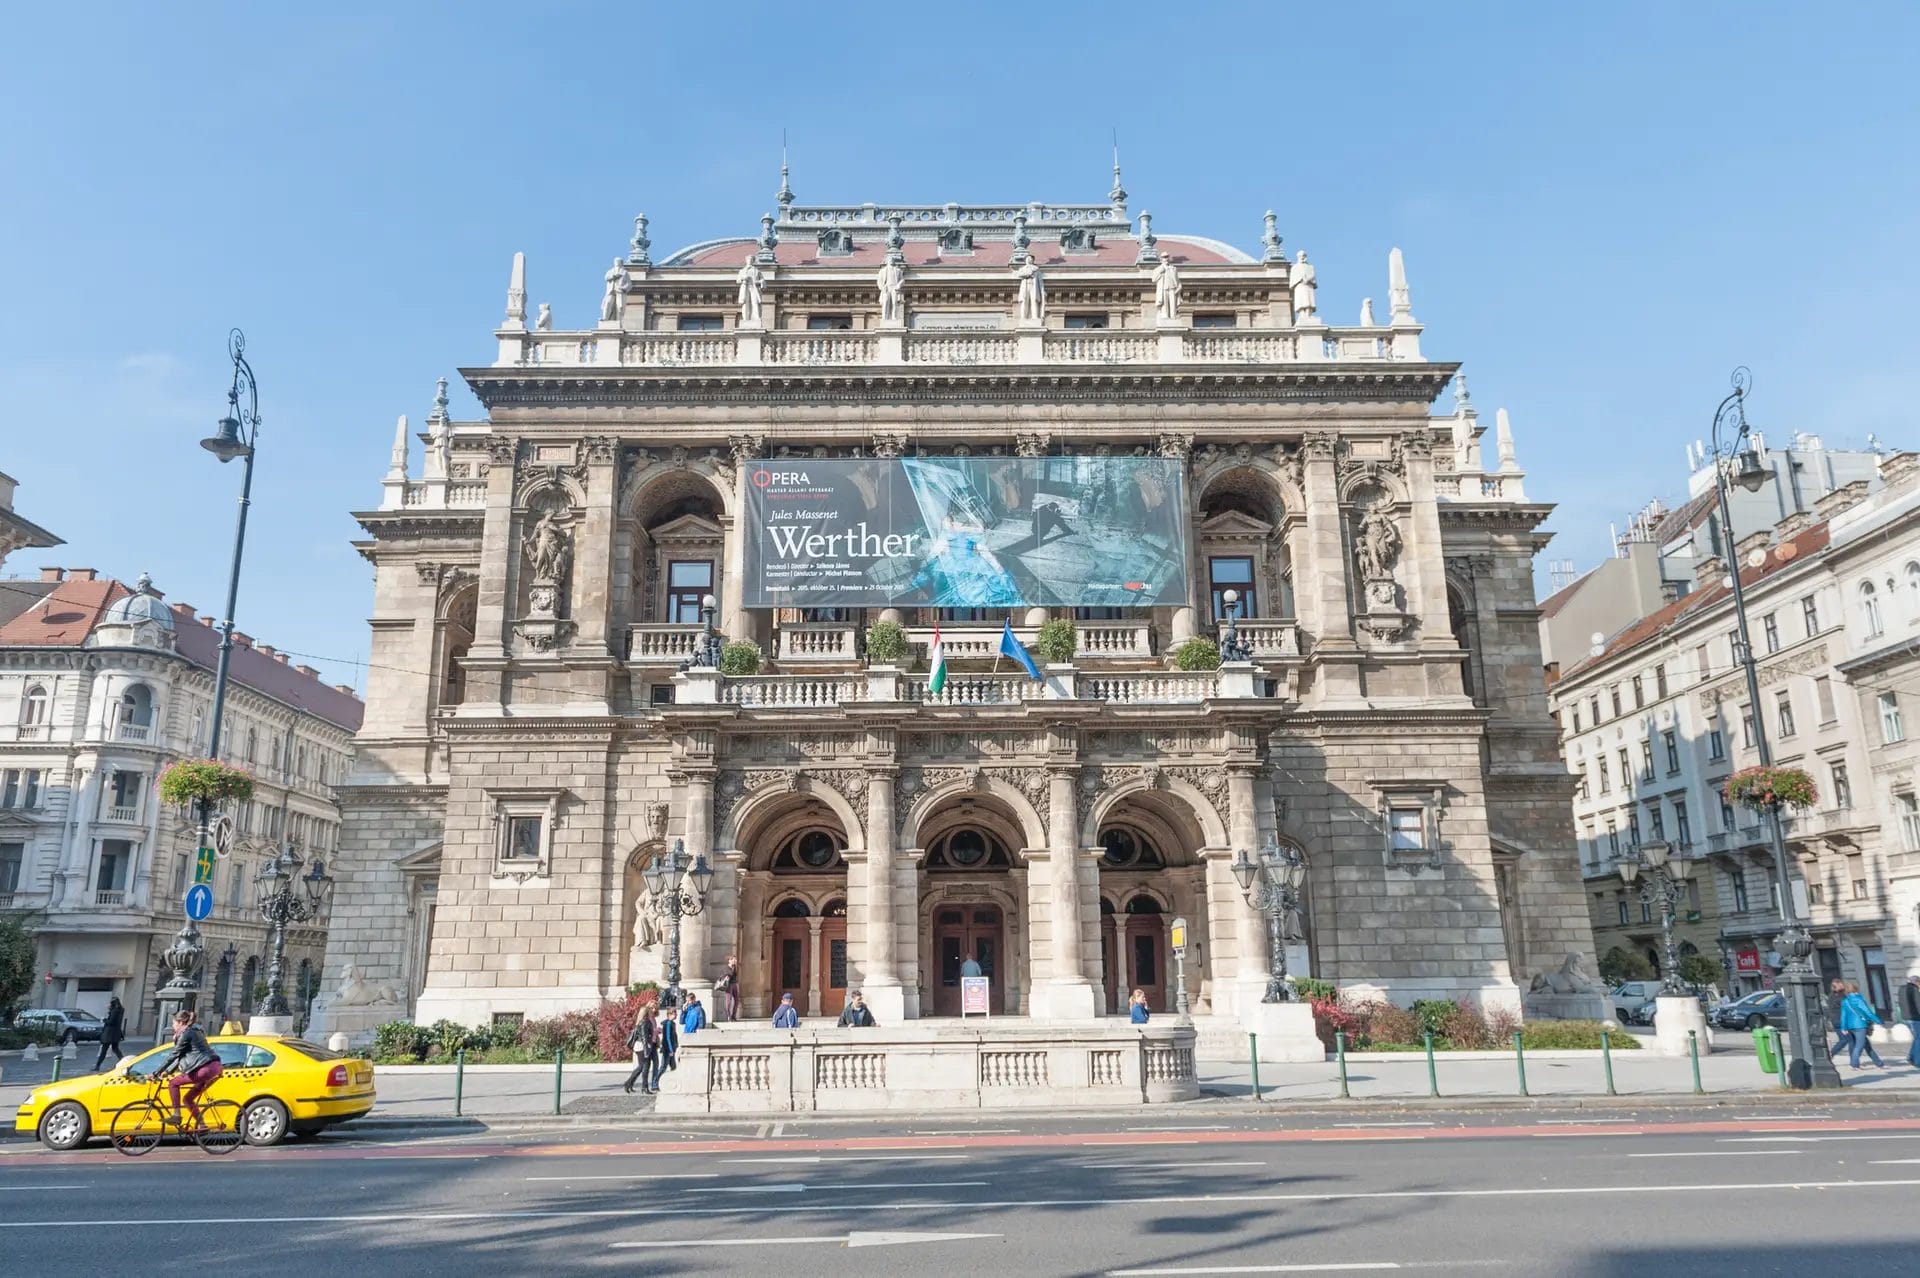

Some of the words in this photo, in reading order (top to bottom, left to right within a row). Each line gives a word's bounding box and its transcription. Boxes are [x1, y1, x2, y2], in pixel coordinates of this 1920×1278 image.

[752, 469, 811, 488] OPERA
[769, 510, 793, 522] Jules
[796, 509, 838, 520] Massenet
[767, 522, 919, 559] Werther
